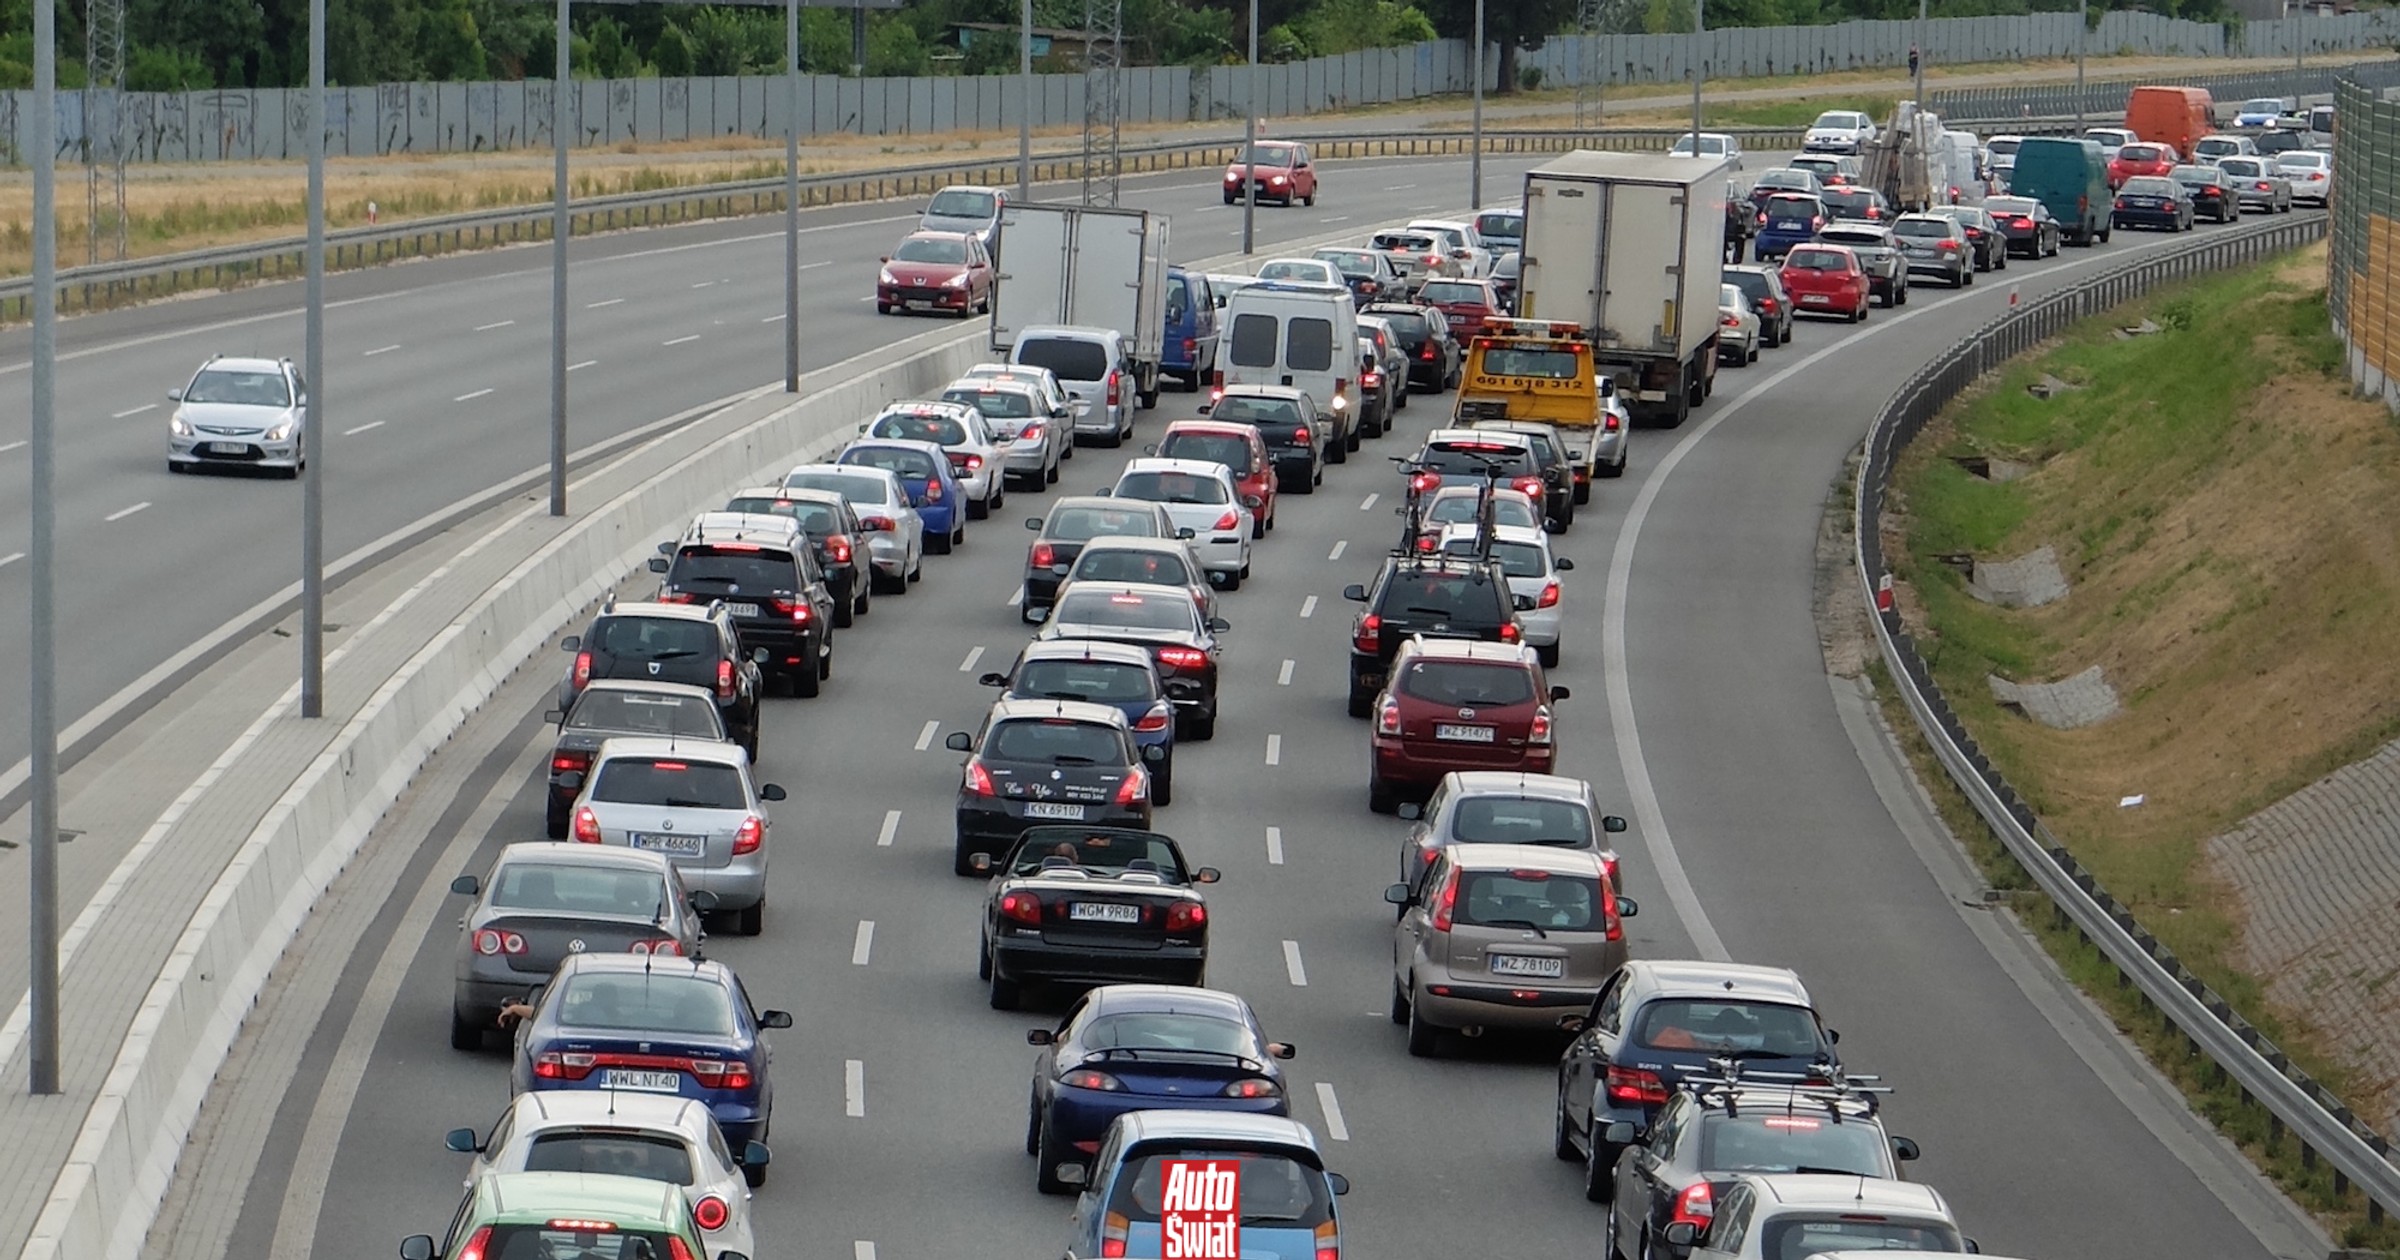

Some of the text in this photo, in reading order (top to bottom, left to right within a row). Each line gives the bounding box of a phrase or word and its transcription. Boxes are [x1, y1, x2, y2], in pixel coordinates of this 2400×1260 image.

[1031, 802, 1046, 814] KN
[1078, 905, 1137, 919] WGM 9R86
[1501, 958, 1559, 971] WZ 78109
[609, 1072, 677, 1088] WWL NT40
